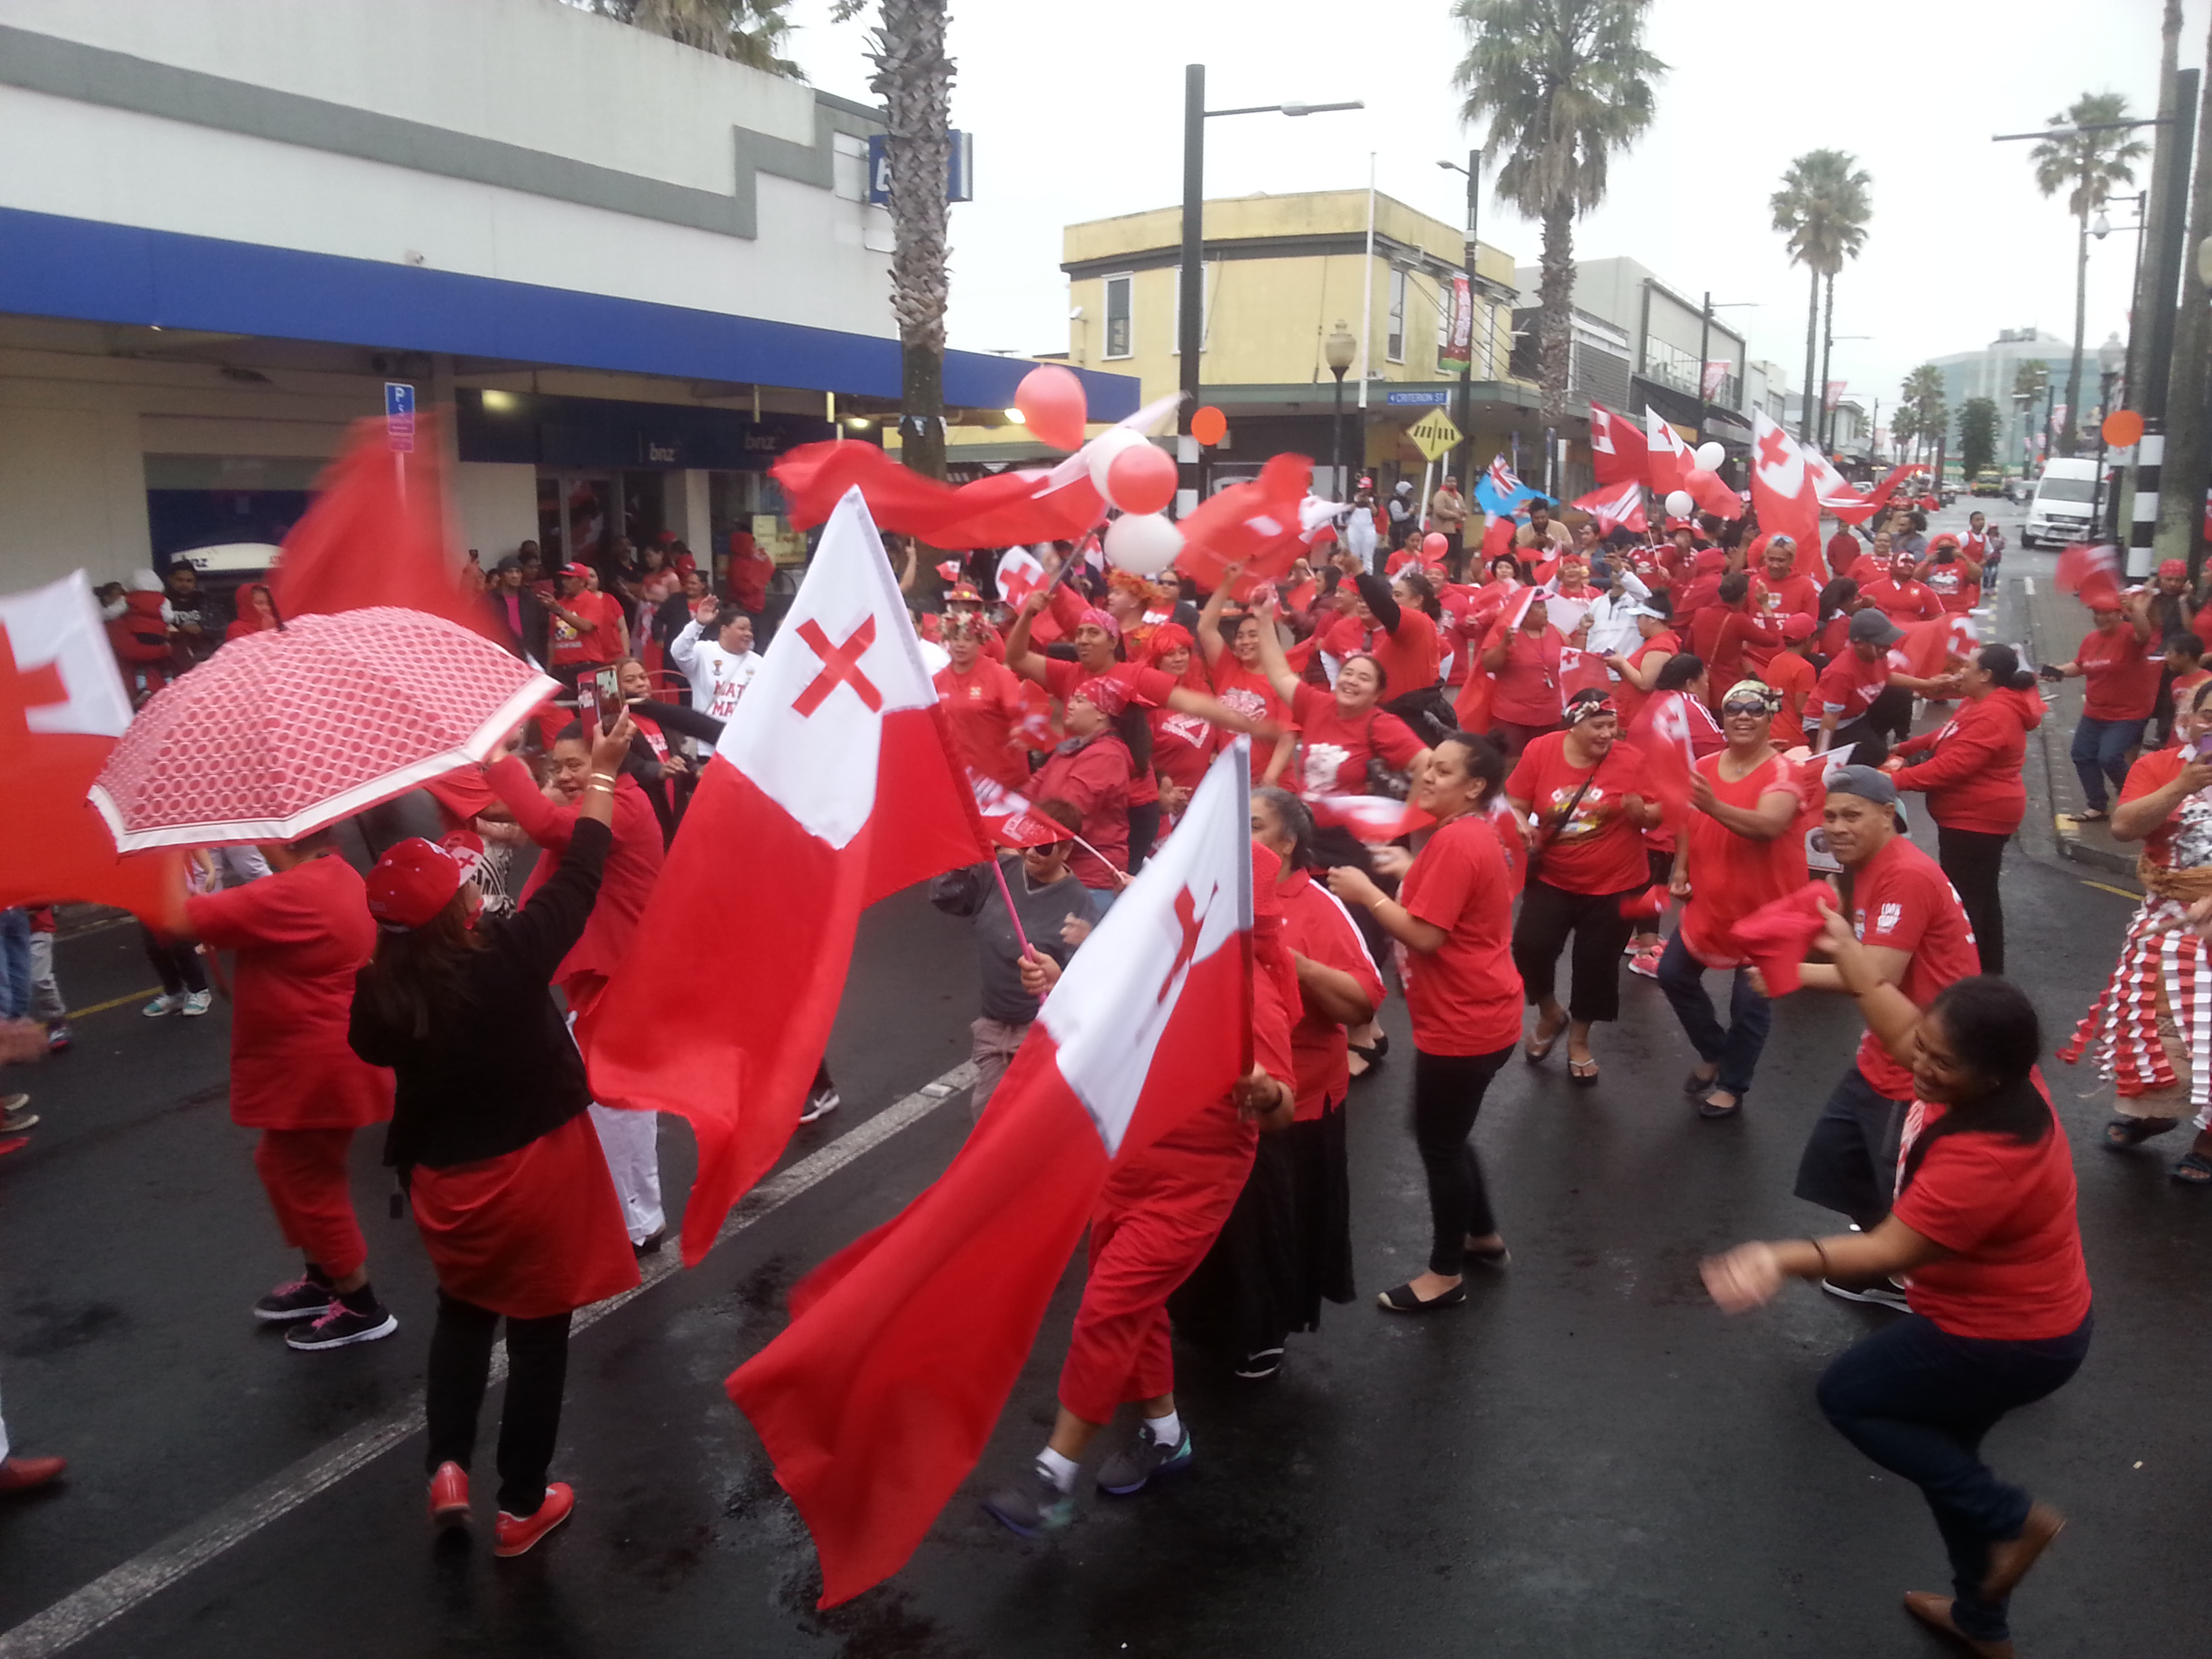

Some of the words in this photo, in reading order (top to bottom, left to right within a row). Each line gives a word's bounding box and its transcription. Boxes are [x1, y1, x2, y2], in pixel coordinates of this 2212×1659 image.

[394, 386, 405, 403] P
[1395, 392, 1433, 403] CRITERION
[1434, 392, 1444, 402] ST
[744, 431, 777, 451] bnz
[649, 441, 676, 462] bnz
